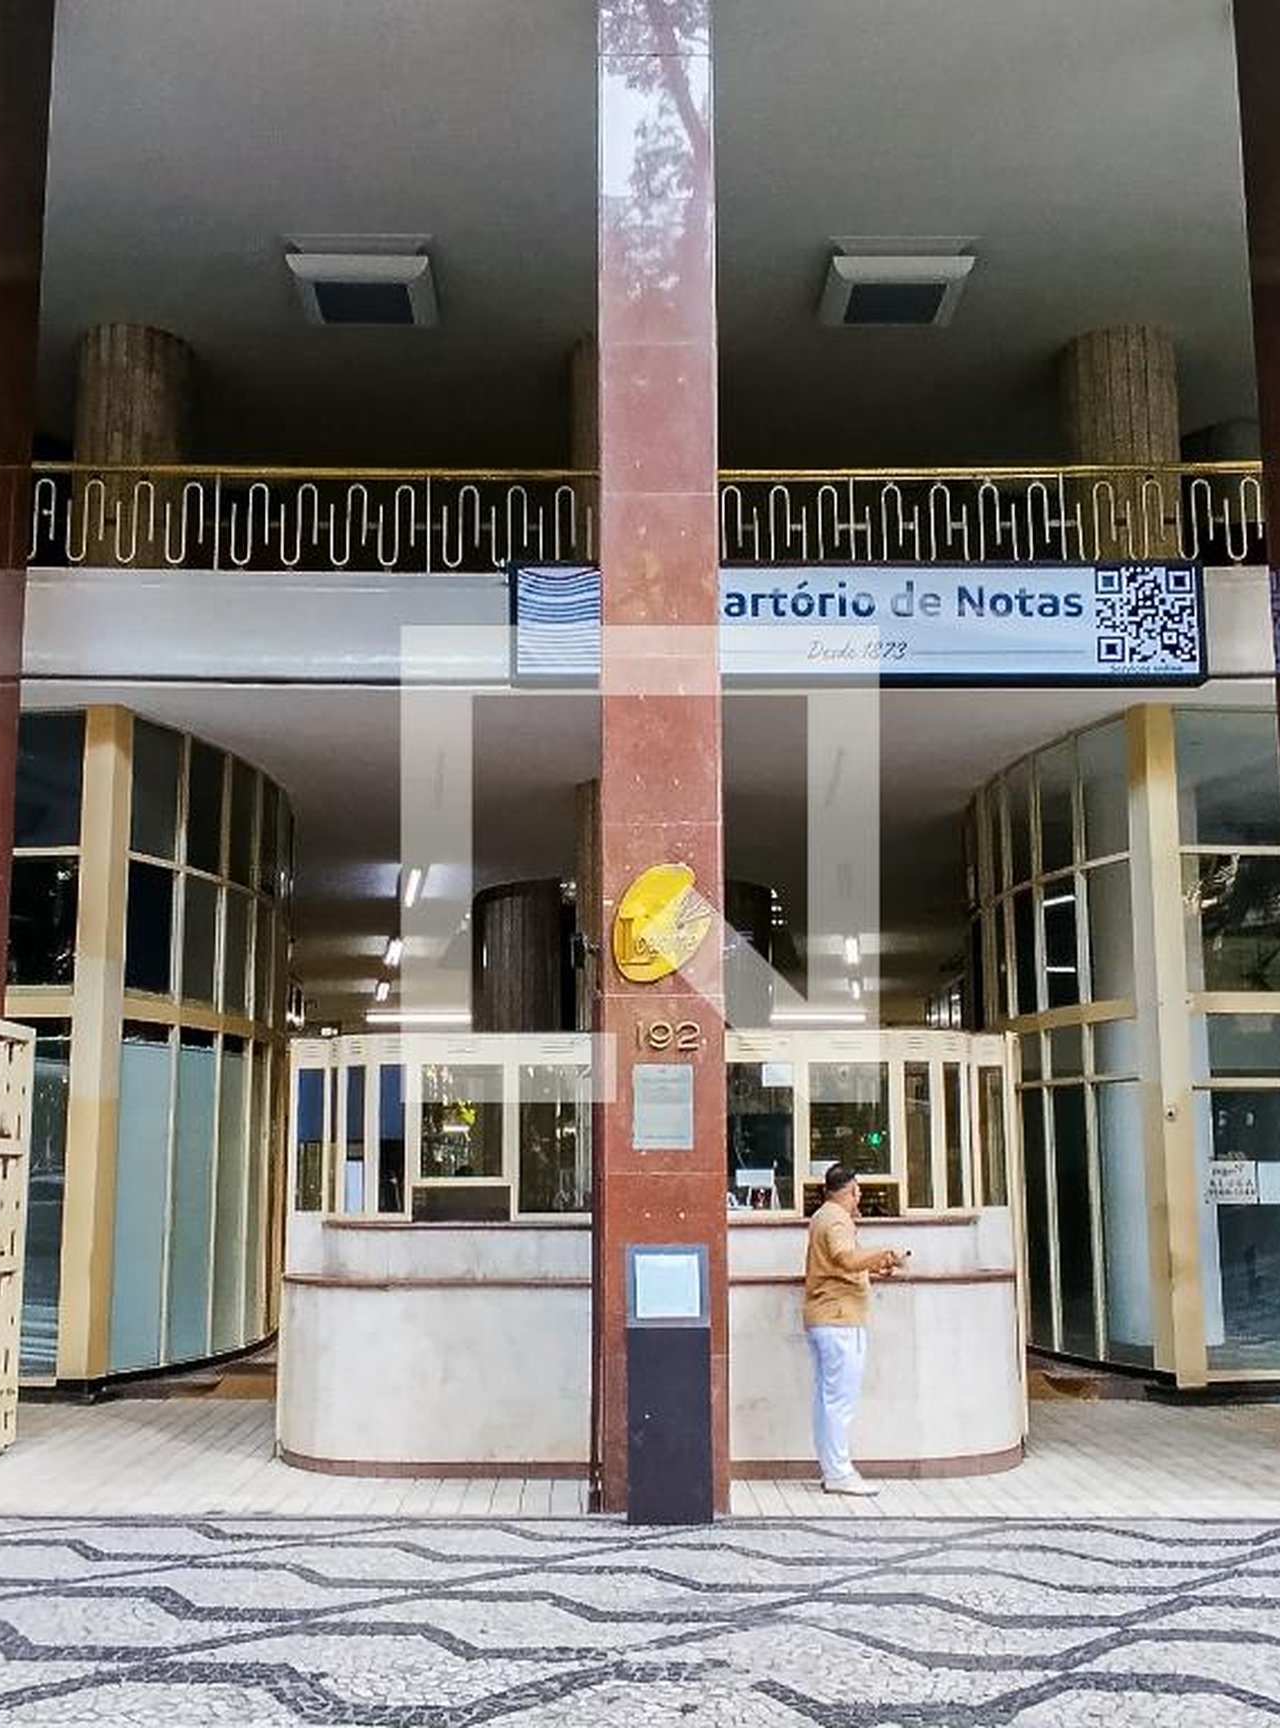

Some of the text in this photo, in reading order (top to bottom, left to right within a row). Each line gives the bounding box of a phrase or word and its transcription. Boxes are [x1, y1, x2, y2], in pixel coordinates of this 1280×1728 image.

[718, 580, 1084, 618] artório de Notas
[863, 640, 908, 660] 1873
[635, 1021, 700, 1051] 192
